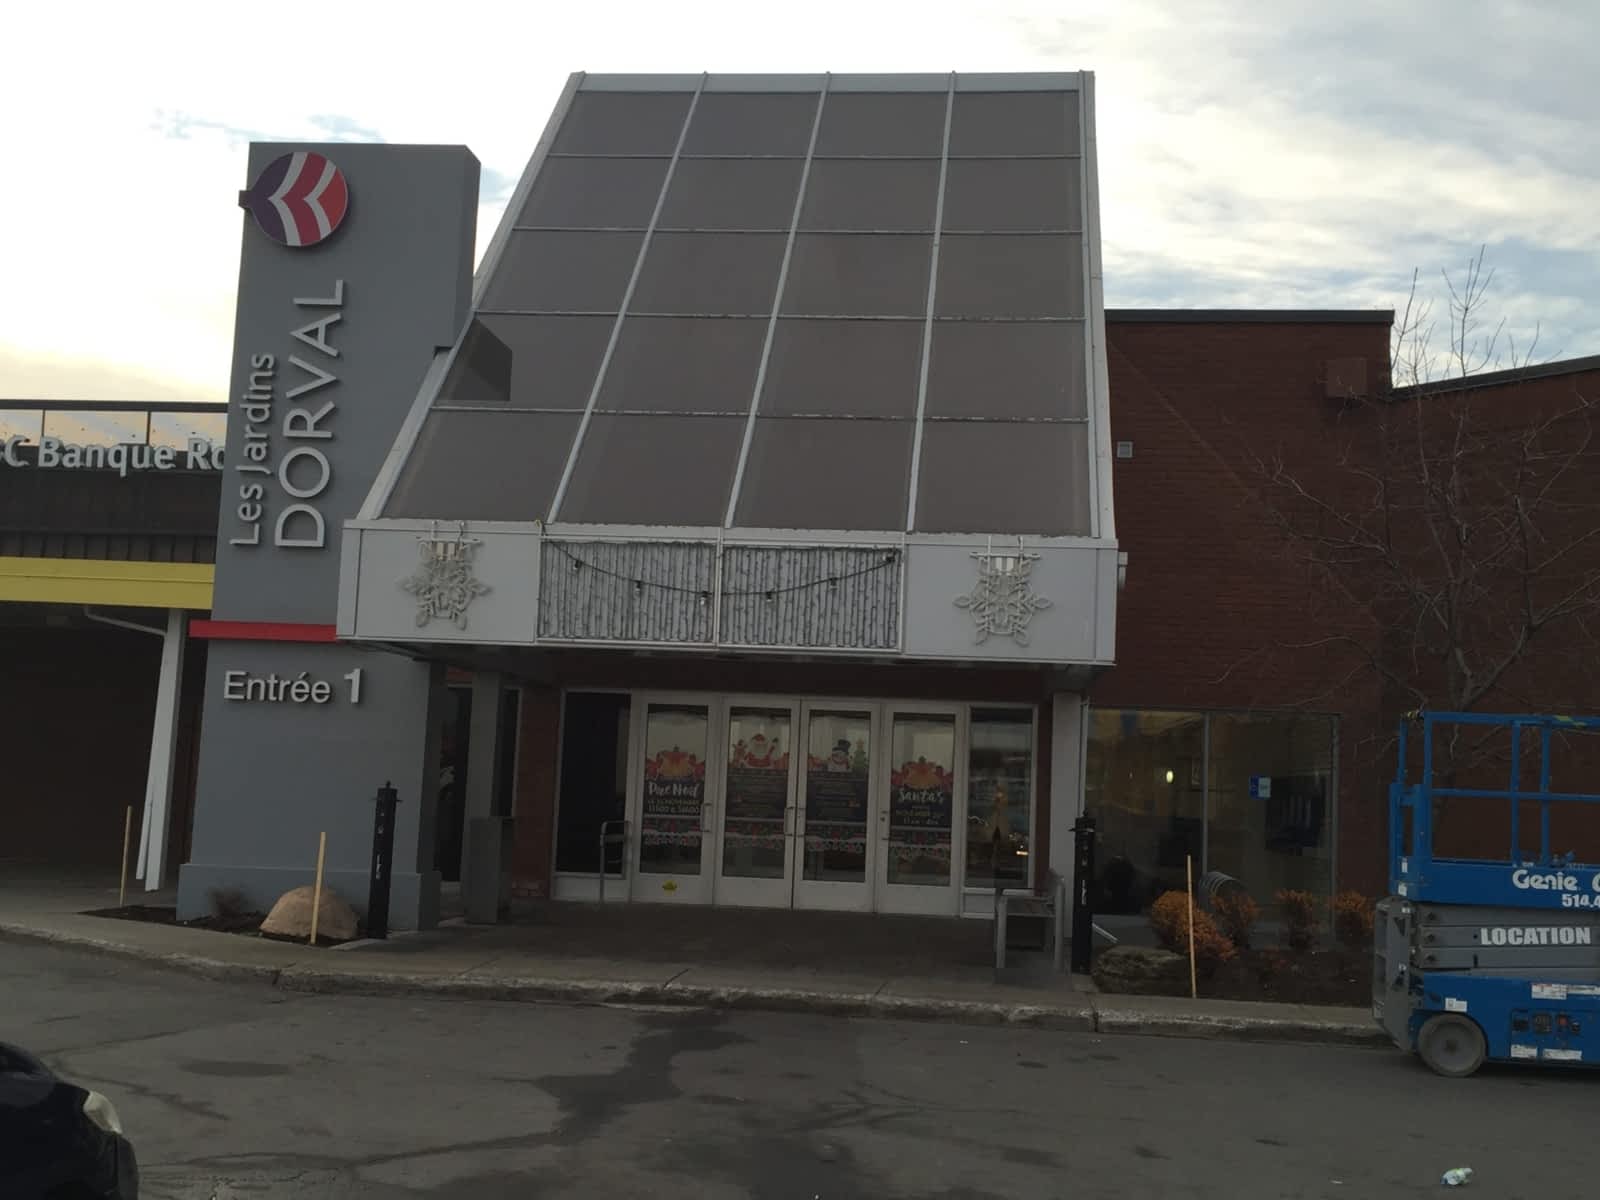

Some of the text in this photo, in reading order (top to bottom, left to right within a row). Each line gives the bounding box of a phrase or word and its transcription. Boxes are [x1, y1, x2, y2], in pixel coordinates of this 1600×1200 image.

[274, 279, 344, 547] DORVAL
[0, 434, 30, 468] C
[37, 434, 177, 478] Banque
[229, 353, 275, 545] Les Jardins
[223, 667, 362, 704] Entrée 1
[1511, 869, 1578, 891] Genie
[1480, 927, 1591, 946] LOCATION
